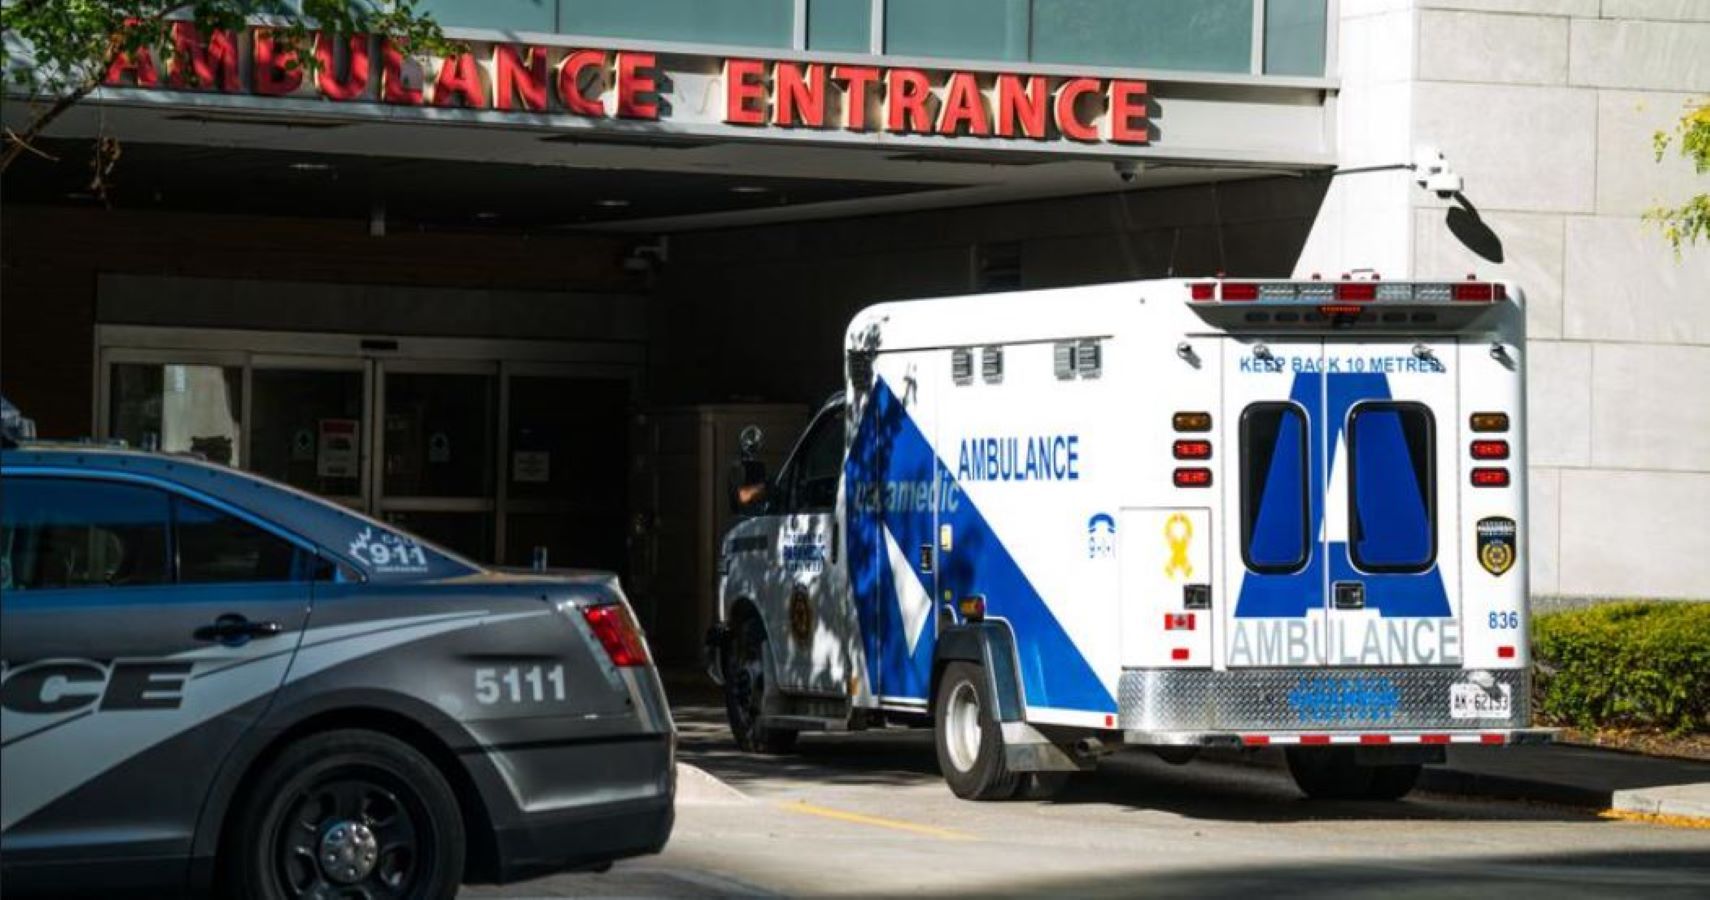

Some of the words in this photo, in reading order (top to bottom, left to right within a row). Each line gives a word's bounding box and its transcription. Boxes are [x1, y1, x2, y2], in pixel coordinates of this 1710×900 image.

[104, 18, 657, 118] AMBULANCE
[722, 58, 1149, 142] ENTRANCE
[1291, 357, 1340, 373] BACK
[1346, 357, 1365, 373] 10
[958, 435, 1080, 481] AMBULANCE
[1488, 610, 1519, 630] 836
[1229, 618, 1460, 666] AMBULANCE
[475, 664, 566, 705] 5111
